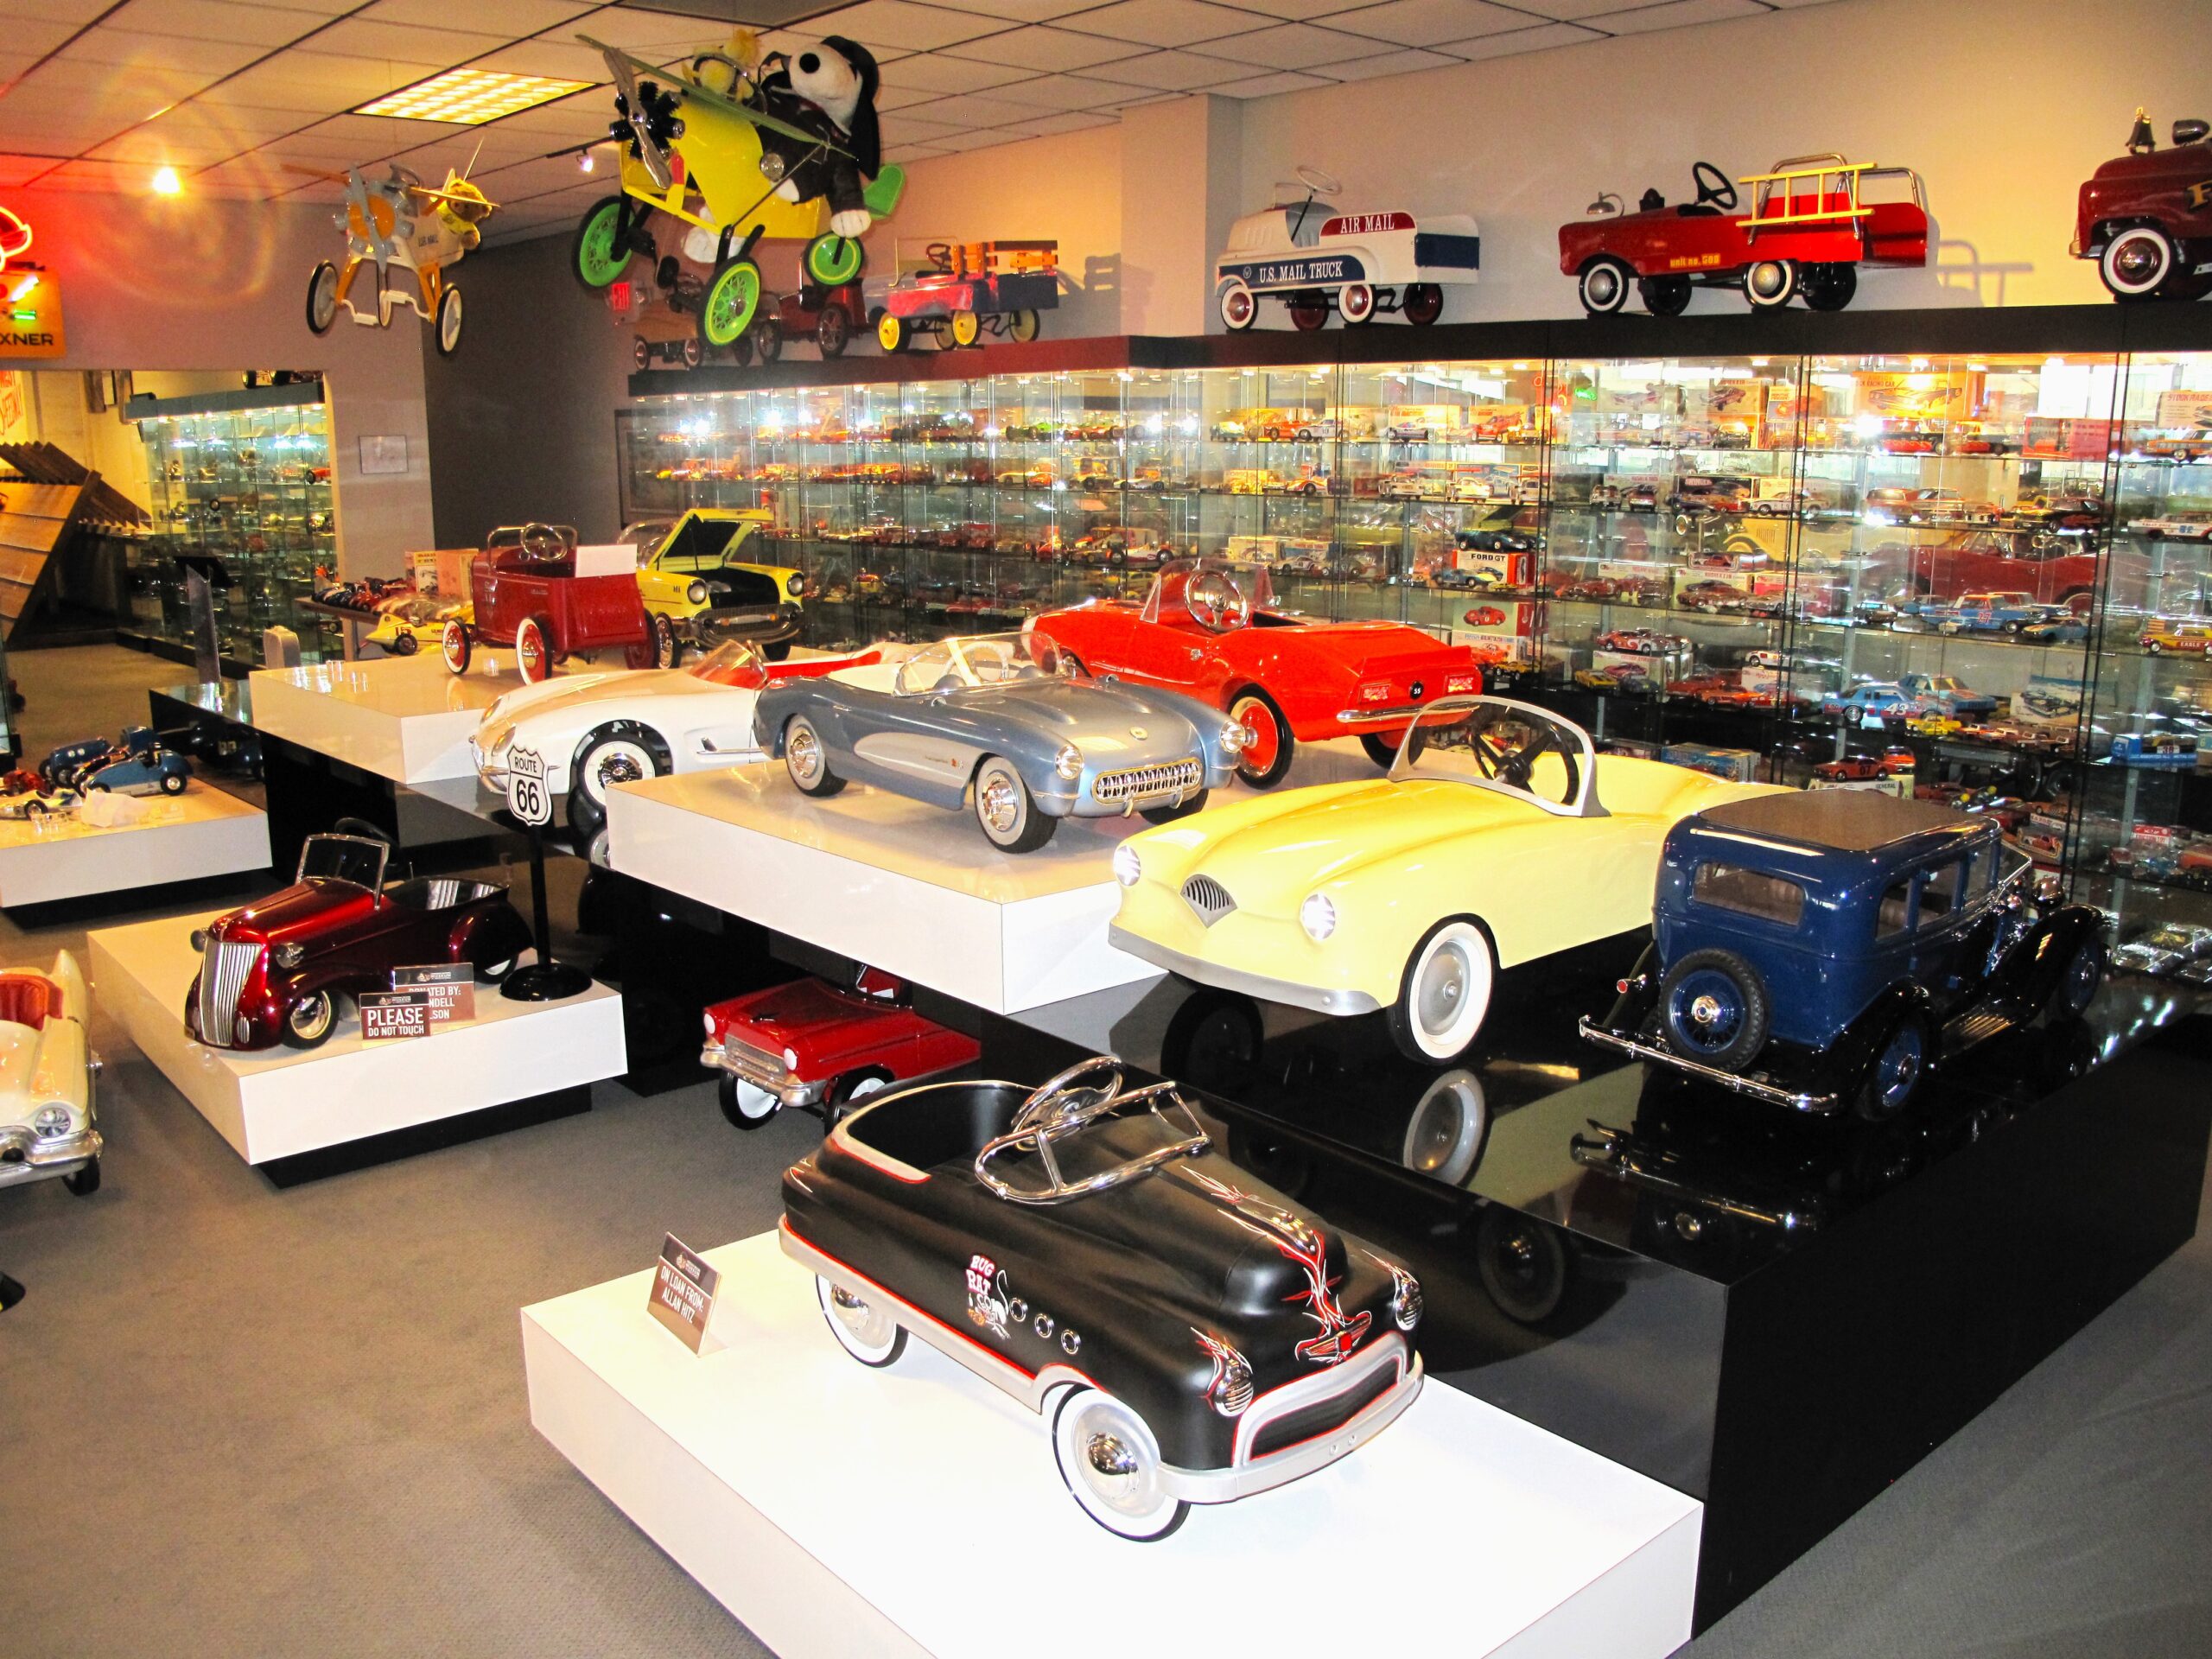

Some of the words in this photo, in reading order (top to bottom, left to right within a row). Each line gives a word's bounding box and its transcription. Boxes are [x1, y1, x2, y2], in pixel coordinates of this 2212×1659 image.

[1340, 218, 1360, 234] AIR
[1364, 214, 1395, 232] MAIL
[1259, 267, 1276, 283] U.S.
[1279, 263, 1306, 281] MAIL
[1309, 260, 1343, 279] TRUCK
[1885, 702, 1909, 715] 43
[514, 756, 537, 772] ROUTE
[516, 779, 539, 815] 66
[448, 986, 461, 996] BY:
[367, 1007, 424, 1027] PLEASE
[368, 1027, 379, 1037] DO
[381, 1027, 397, 1037] NOT
[399, 1025, 424, 1036] TOUCH
[660, 1266, 670, 1282] ON
[669, 1274, 686, 1296] LOAN
[684, 1287, 704, 1313] FROM:
[966, 1269, 991, 1295] RAT
[662, 1287, 682, 1312] ALLAN
